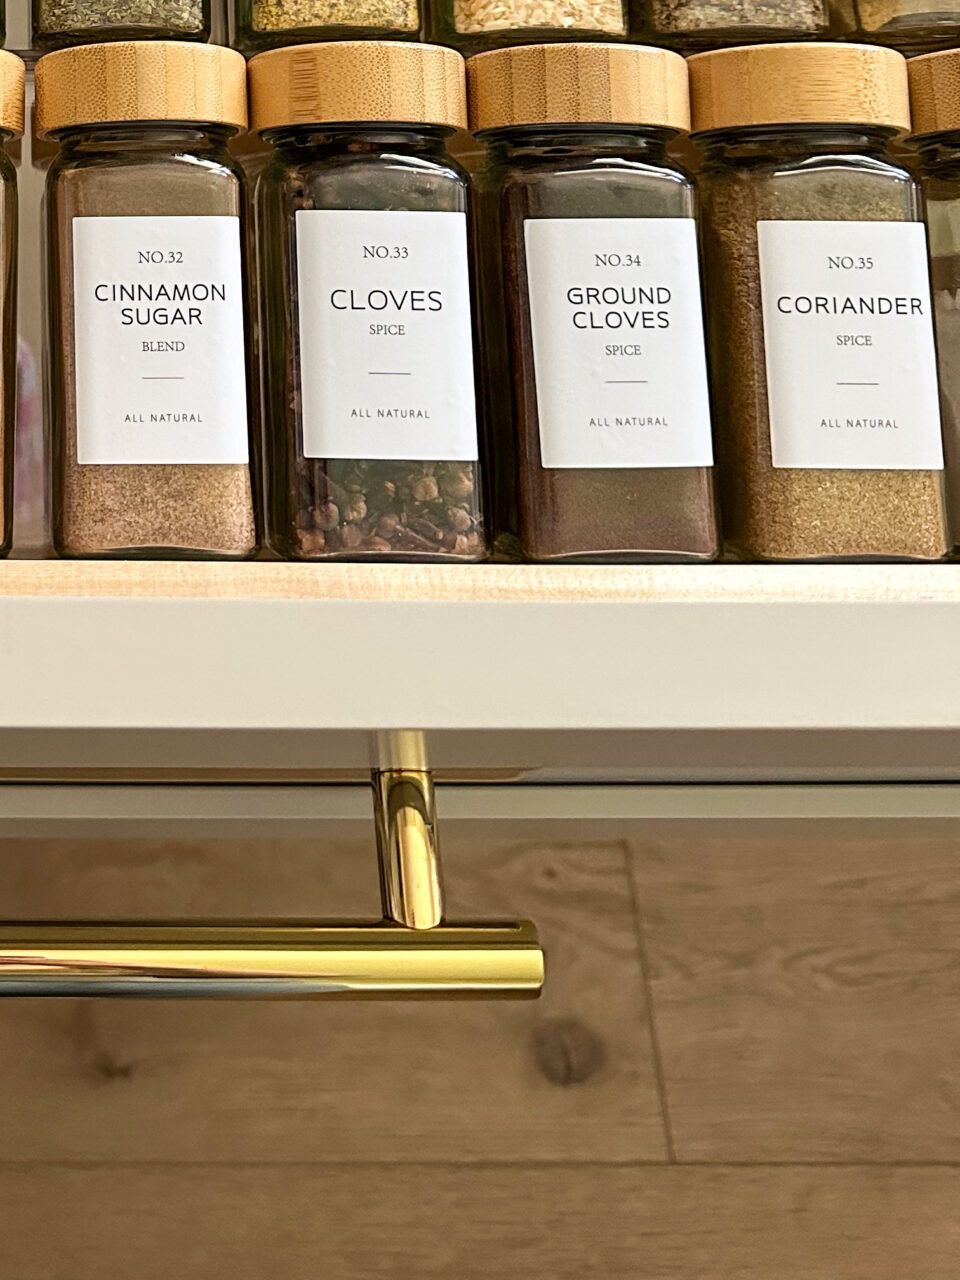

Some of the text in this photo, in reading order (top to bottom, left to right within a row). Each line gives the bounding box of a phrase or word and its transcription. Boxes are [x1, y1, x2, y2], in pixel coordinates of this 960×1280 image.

[137, 250, 184, 264] NO.32
[362, 245, 409, 260] NO.33
[593, 253, 642, 268] NO.34
[826, 255, 874, 270] NO.35
[94, 283, 226, 303] CINNAMON
[330, 288, 443, 312] CLOVES
[566, 286, 672, 306] GROUND
[776, 295, 924, 316] CORIANDER
[120, 307, 204, 326] SUGAR
[572, 310, 670, 330] CLOVES
[368, 323, 407, 336] SPICE
[141, 337, 186, 353] BLEND
[835, 334, 873, 347] SPICE
[604, 344, 643, 357] SPICE
[123, 412, 204, 424] ALL NATURAL
[350, 408, 431, 420] ALL NATURAL
[588, 416, 669, 428] ALL NATURAL
[820, 418, 899, 430] ALL NATURAL
